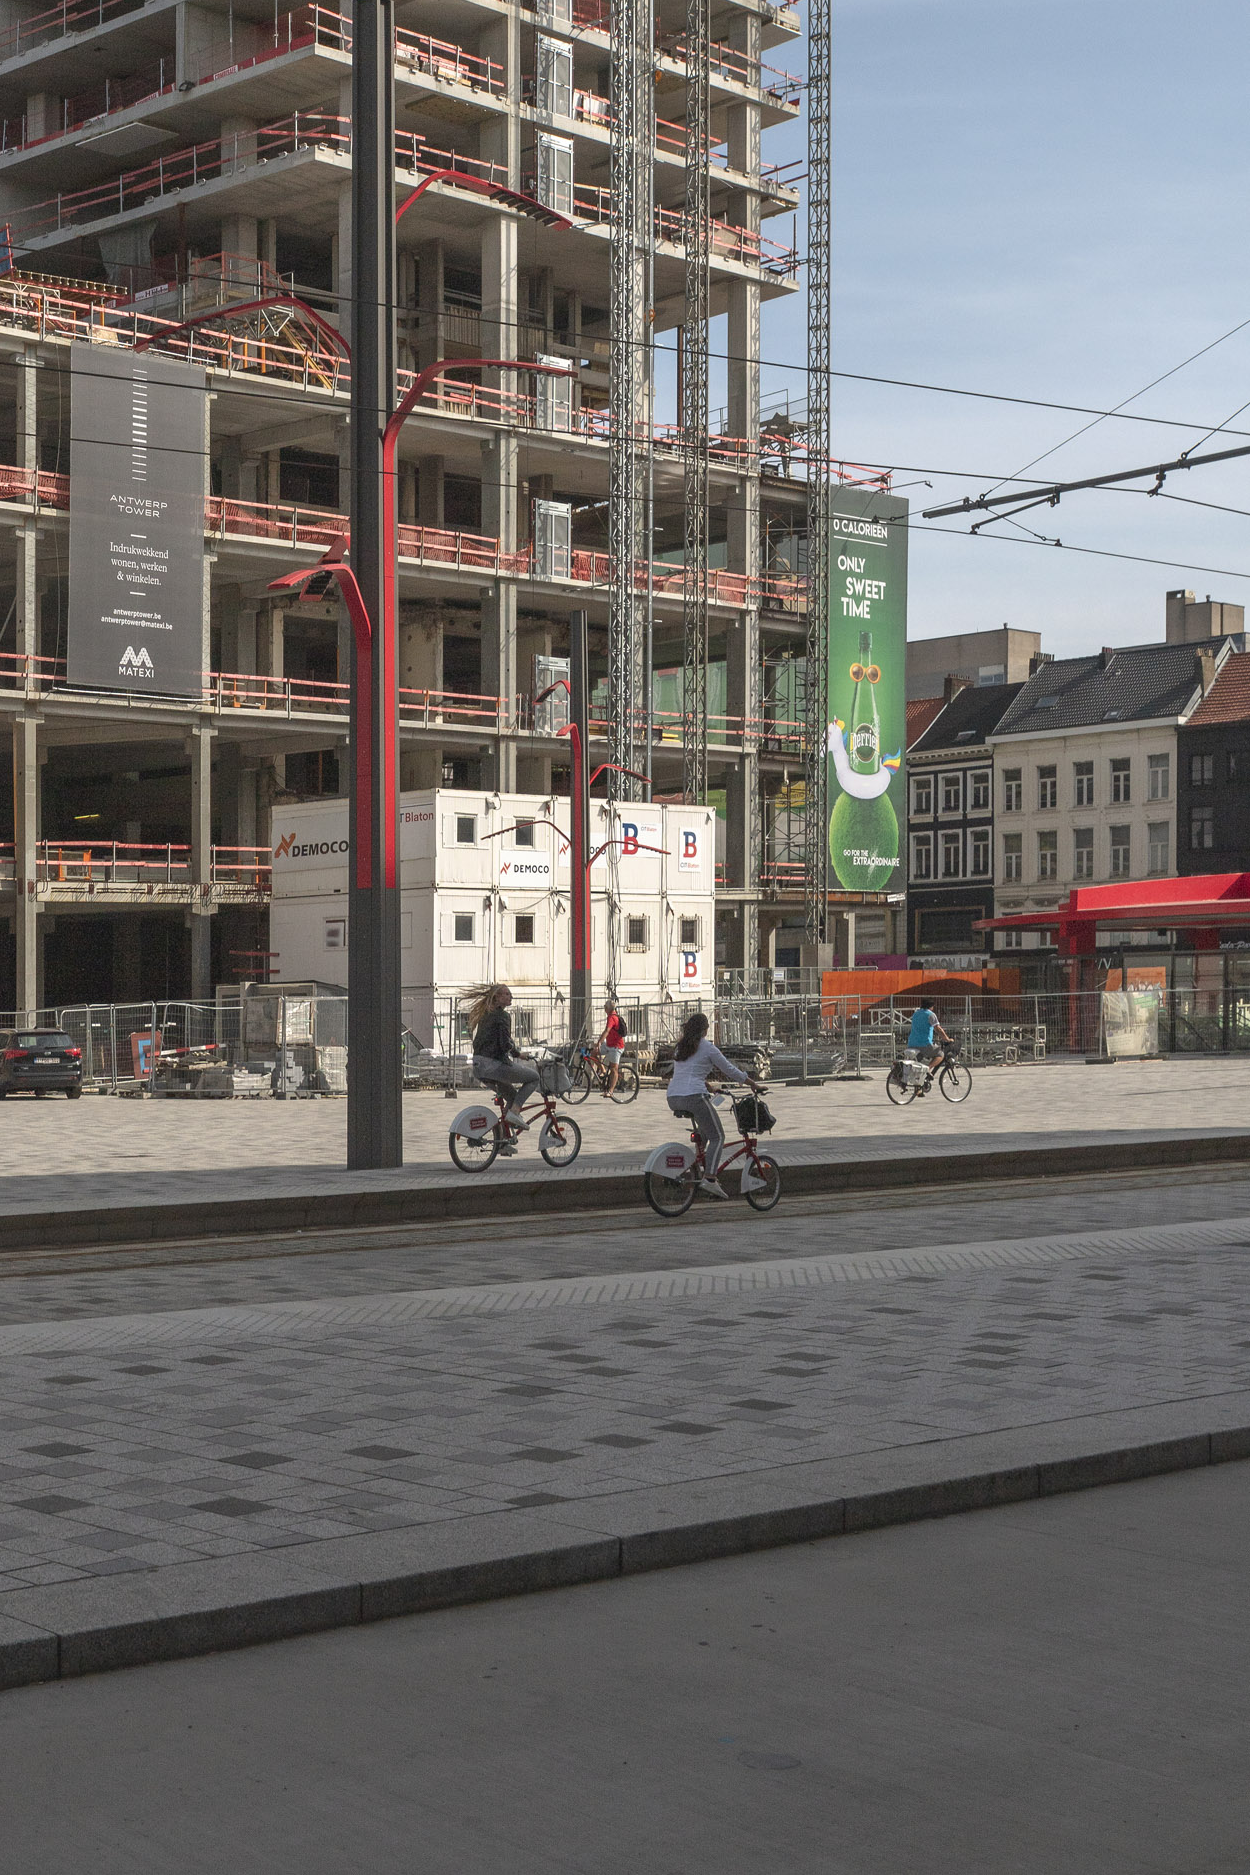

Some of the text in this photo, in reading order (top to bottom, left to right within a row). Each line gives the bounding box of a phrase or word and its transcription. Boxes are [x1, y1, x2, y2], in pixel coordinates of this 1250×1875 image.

[110, 494, 168, 509] ANTWERP
[117, 504, 160, 518] TOWER
[833, 518, 888, 539] 0 CALORIEËN
[110, 541, 169, 559] Indrukwekkend
[111, 559, 168, 572] wonen, werken
[838, 555, 866, 573] ONLY
[117, 570, 162, 586] & winkelen.
[846, 577, 886, 600] SWEET
[113, 608, 161, 620] antwerptower.be
[841, 597, 871, 619] TIME
[101, 615, 173, 630] antwerptower@matexi.be
[118, 665, 155, 678] MATEXI
[405, 811, 434, 823] Blaton
[292, 840, 349, 857] DEMOCO
[514, 864, 549, 873] DEMOCO
[853, 856, 899, 867] EXTRAORDINAIRE
